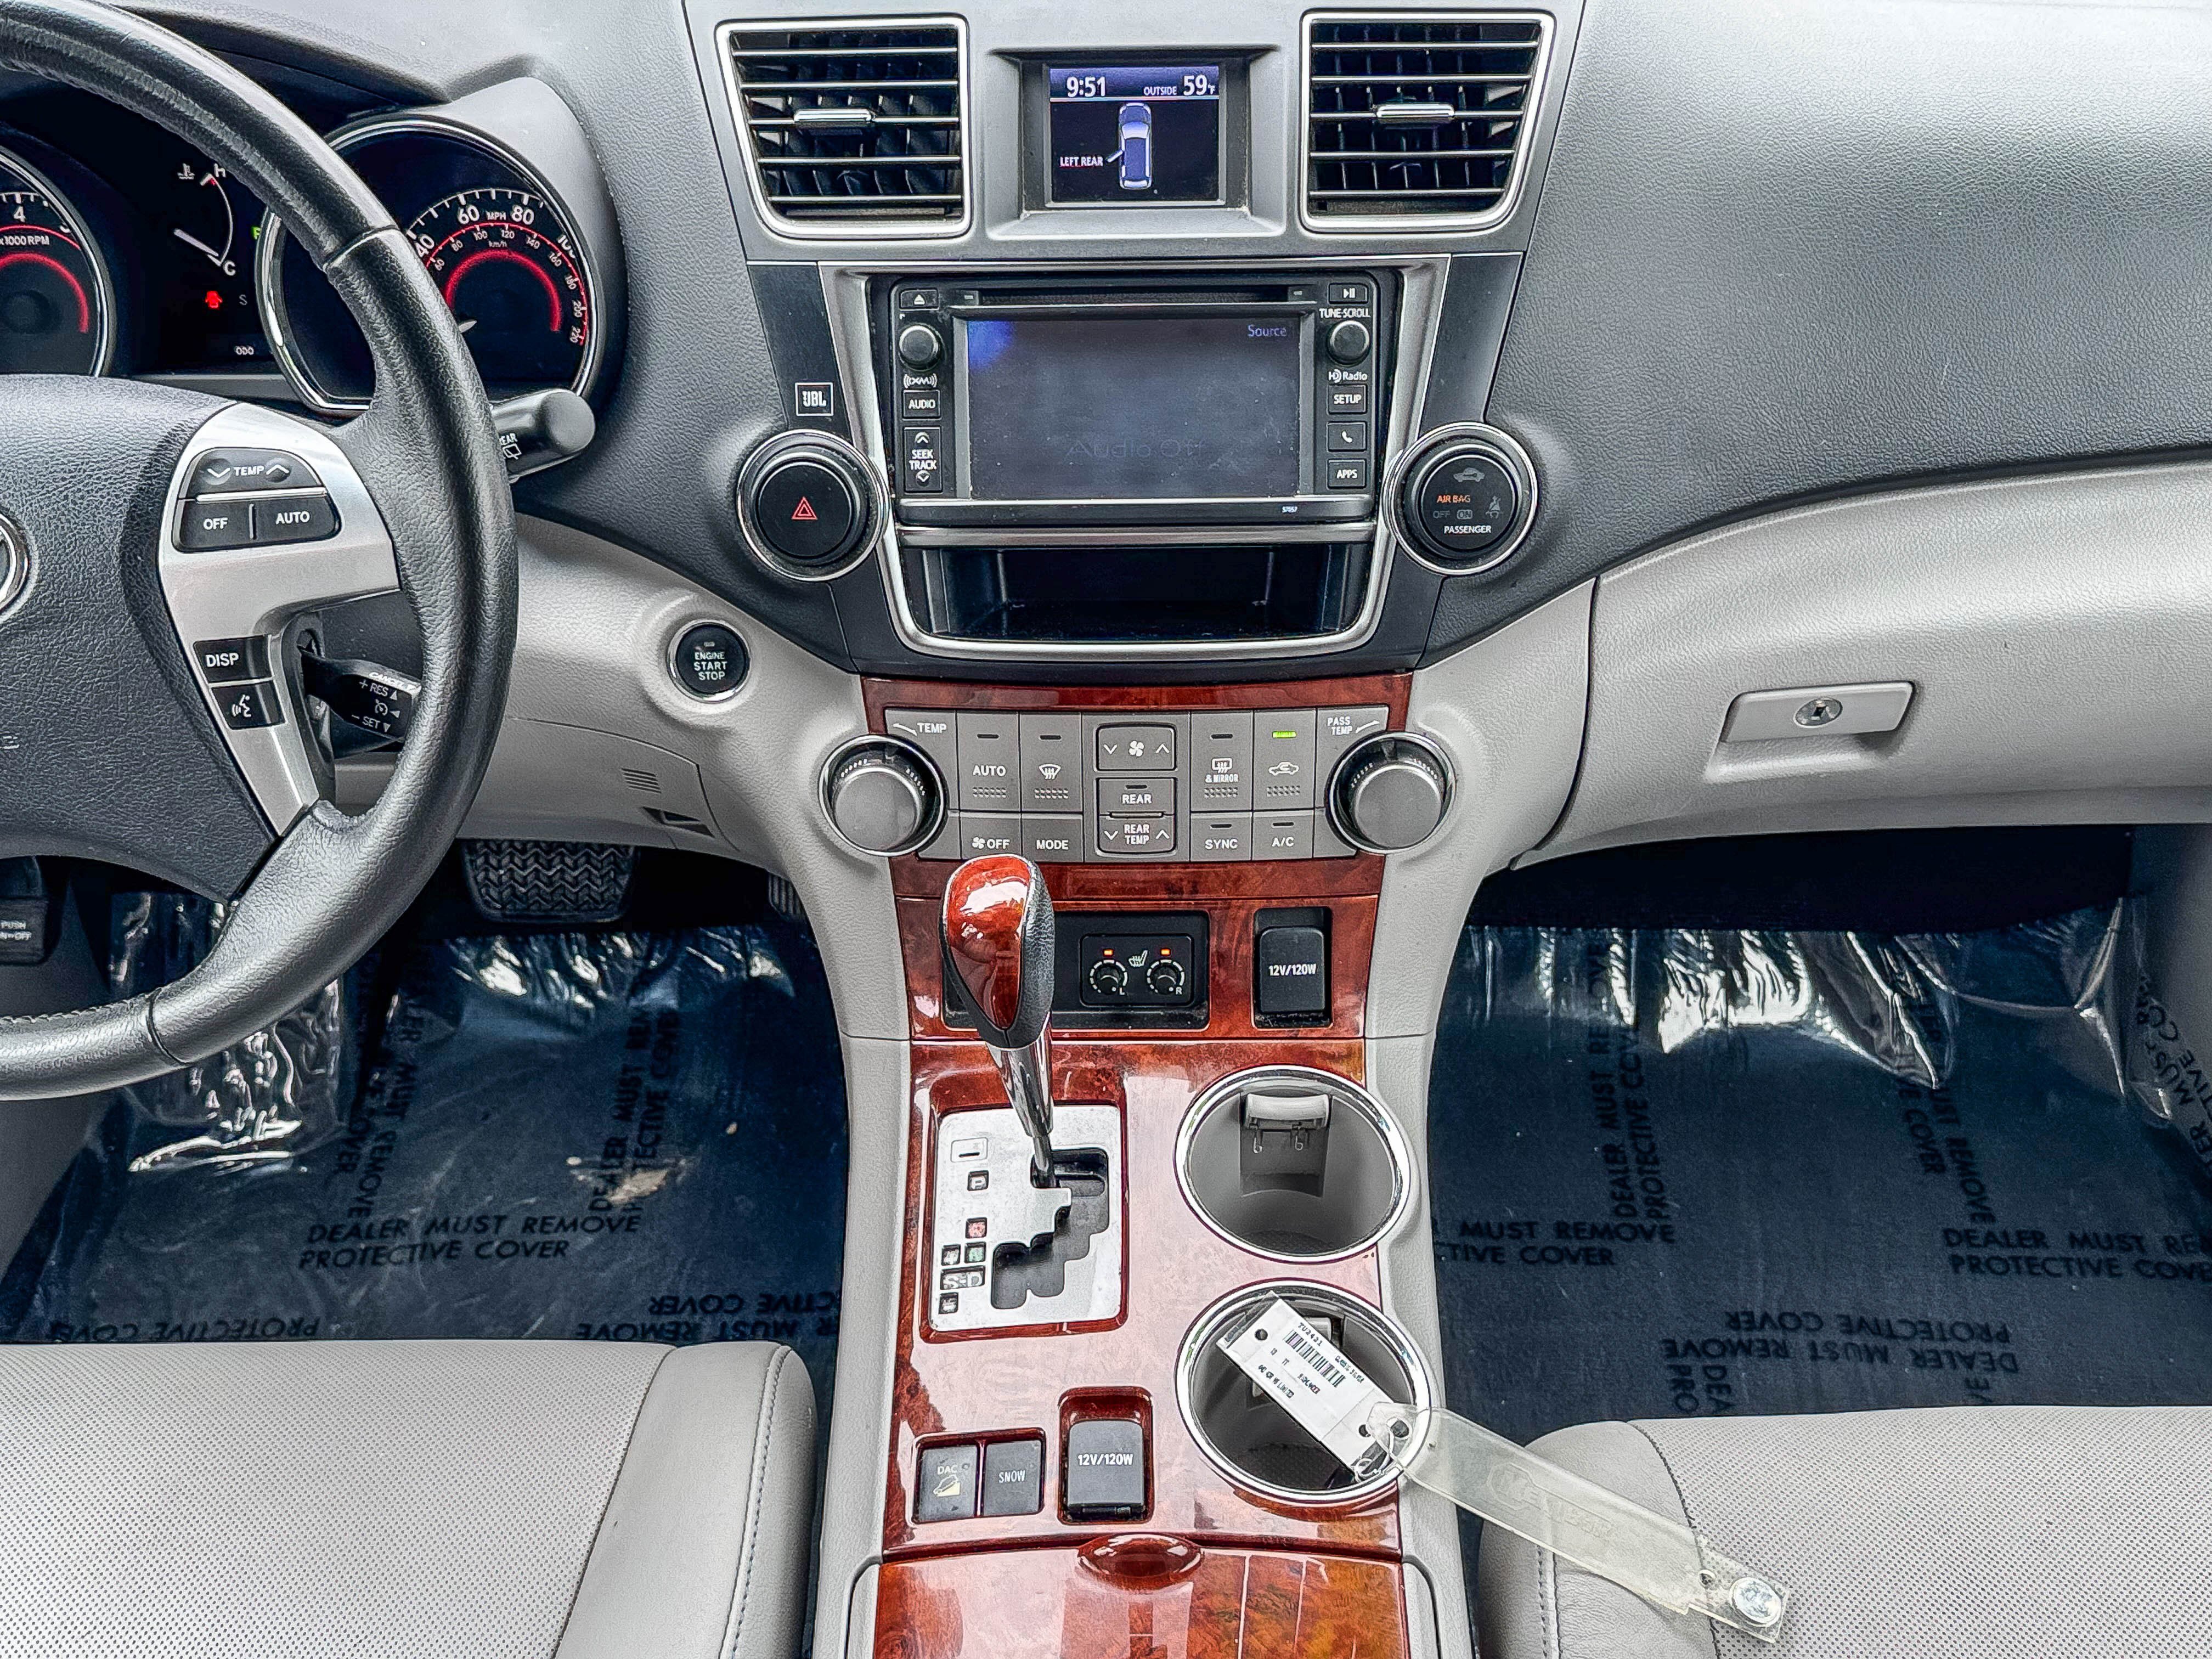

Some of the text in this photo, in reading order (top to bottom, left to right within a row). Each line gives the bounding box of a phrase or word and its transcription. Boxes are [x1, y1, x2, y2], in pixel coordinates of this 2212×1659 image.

[1066, 76, 1105, 97] 9:51
[1144, 86, 1177, 96] OUTSIDE
[1060, 156, 1103, 167] LEFT REAR
[13, 206, 25, 222] 4
[458, 205, 479, 224] 60
[487, 212, 506, 221] MPH
[512, 205, 535, 225] 80
[473, 230, 488, 241] 100
[501, 230, 516, 239] 120
[27, 235, 50, 246] RPM
[416, 234, 435, 257] 40
[224, 261, 236, 275] C
[239, 295, 247, 305] S
[1248, 324, 1287, 337] Source
[1343, 370, 1368, 381] Radio
[802, 391, 827, 408] JBL
[909, 399, 936, 409] AUDIO
[1334, 394, 1362, 404] SETUP
[499, 433, 518, 445] EAR
[912, 449, 934, 459] SEEK
[909, 460, 936, 470] TRACK
[234, 466, 264, 476] TEMP
[1336, 469, 1358, 479] APPS
[1436, 495, 1471, 503] AIR BAG
[203, 517, 228, 530] OFF
[275, 511, 311, 525] AUTO
[1443, 525, 1492, 534] PASSENGER
[206, 652, 240, 668] DISP
[695, 652, 725, 660] ENGINE
[693, 661, 727, 671] START
[698, 671, 726, 680] STOP
[370, 682, 389, 697] RES
[362, 716, 381, 729] SET
[1327, 716, 1351, 726] PASS
[917, 722, 947, 733] TEMP
[1331, 725, 1353, 736] TEMP
[972, 765, 1006, 777] AUTO
[1122, 793, 1152, 804] REAR
[1124, 824, 1150, 834] REAR
[986, 838, 1011, 849] OFF
[1036, 839, 1069, 850] MODE
[1124, 834, 1150, 845] TEMP
[1205, 838, 1239, 850] SYNC
[1272, 836, 1295, 848] A/C
[1268, 964, 1317, 976] 12V/120W
[1176, 986, 1182, 995] R
[308, 1215, 641, 1244] DEALER MUST REMOVE
[1459, 1220, 1539, 1241] MUST
[1556, 1220, 1675, 1244] REMOVE
[1942, 1228, 2049, 1250] DEALER
[2069, 1232, 2147, 1254] MUST
[299, 1240, 569, 1268] PROTECTIVE COVER
[1520, 1245, 1616, 1266] COVER
[1949, 1254, 2212, 1283] PROTECTIVE COVE
[650, 1294, 744, 1315] COVER
[1725, 1311, 2011, 1344] PROTECTIVE COVER
[1661, 1338, 2020, 1374] DEALER MUST REMOVE
[1078, 1453, 1133, 1466] 12V/120W
[937, 1465, 958, 1475] DAC
[999, 1470, 1025, 1483] SNOW
